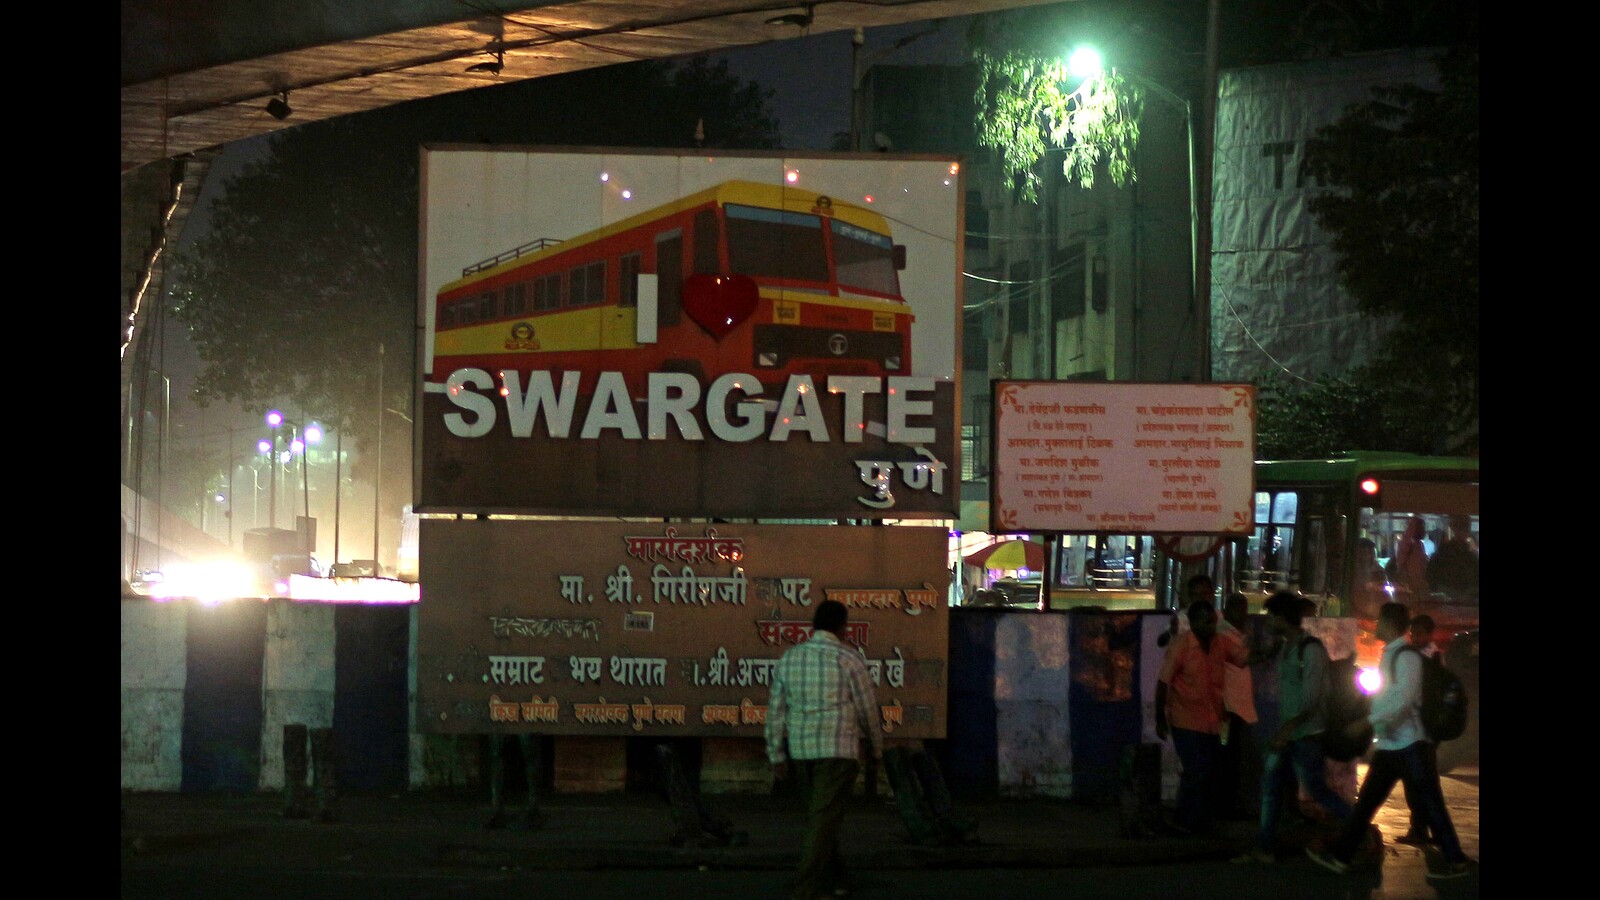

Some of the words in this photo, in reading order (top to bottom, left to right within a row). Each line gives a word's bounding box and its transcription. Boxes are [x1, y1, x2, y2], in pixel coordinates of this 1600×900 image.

[636, 273, 658, 344] I
[443, 367, 937, 445] SWARGATE
[1204, 404, 1234, 415] पाटील
[853, 447, 949, 509] पुणे
[623, 526, 744, 564] मार्गदर्शक
[559, 575, 594, 604] मा.
[605, 565, 642, 604] श्री.
[651, 564, 748, 606] गिरीशजी
[902, 582, 938, 616] पुणे
[631, 695, 654, 731] पुणे
